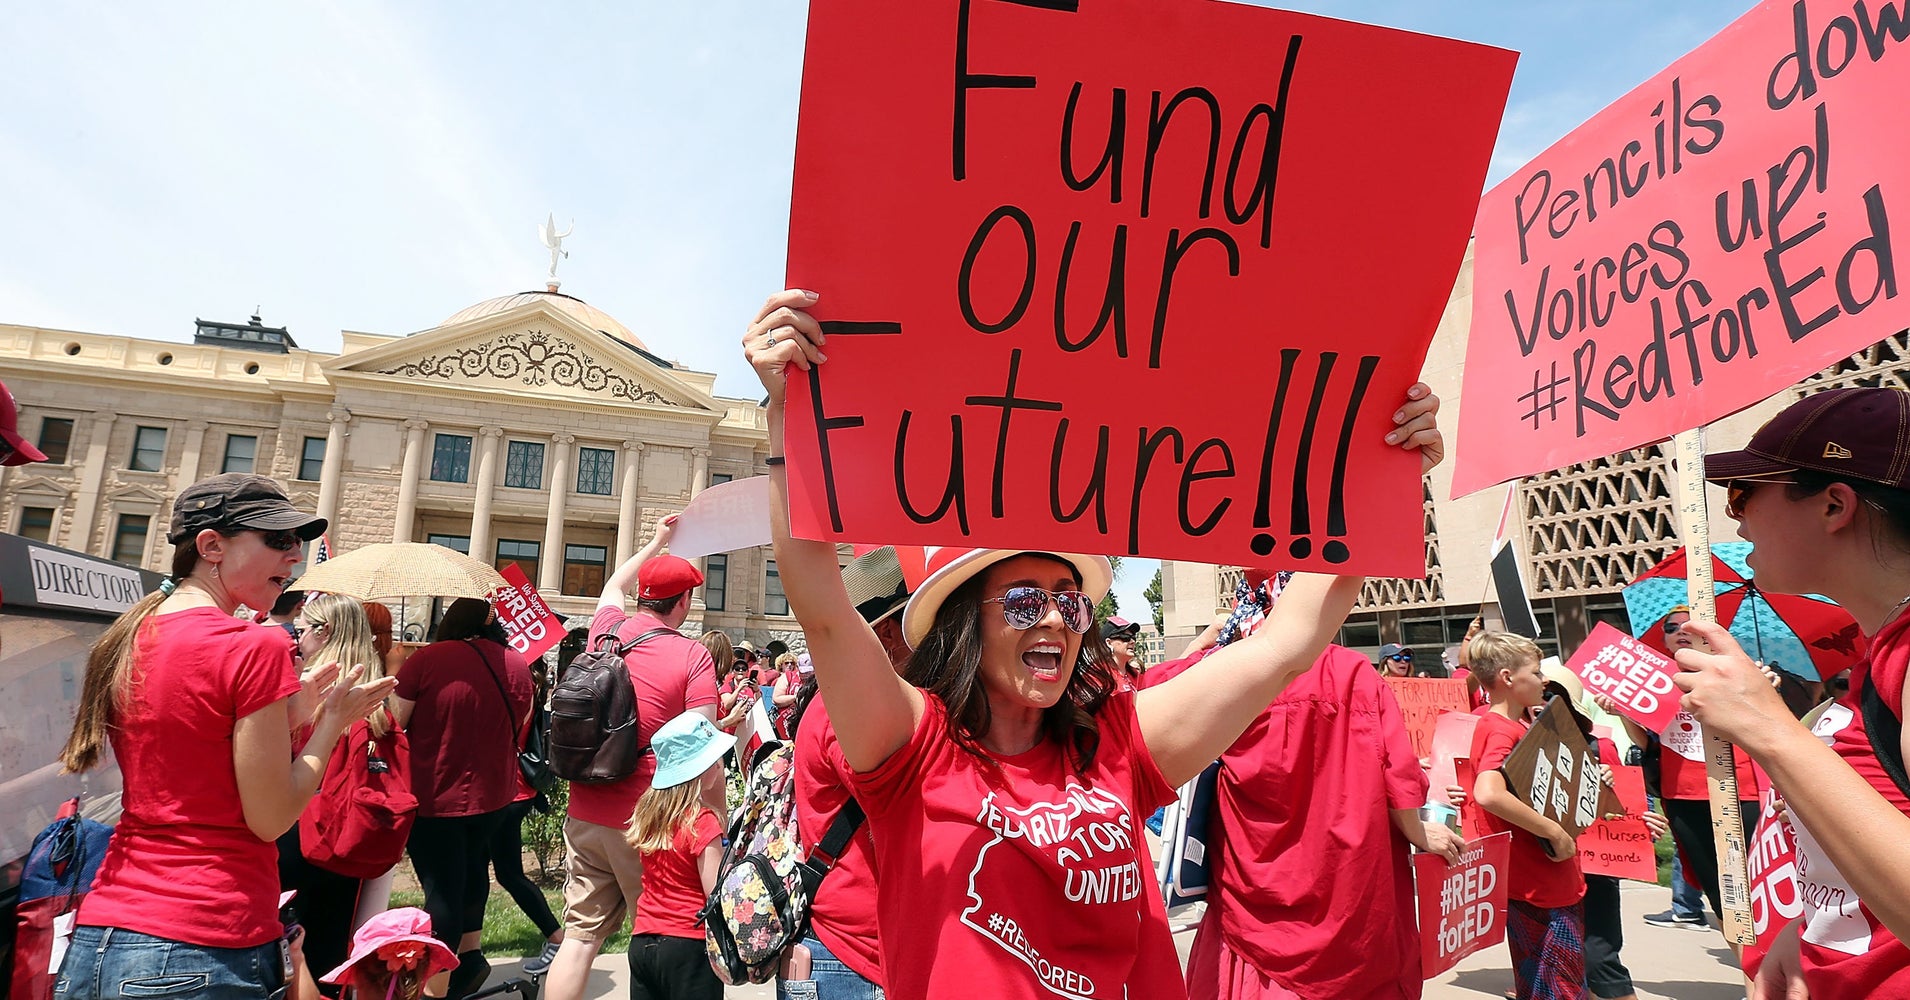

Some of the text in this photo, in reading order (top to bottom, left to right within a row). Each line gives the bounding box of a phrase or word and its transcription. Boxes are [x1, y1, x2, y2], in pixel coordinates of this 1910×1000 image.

[952, 0, 1302, 249] Fund
[1514, 76, 1725, 265] Pencils
[1504, 101, 1829, 358] Voices up!
[957, 204, 1240, 369] our
[1517, 183, 1898, 438] #RedforEd
[807, 321, 1380, 565] Future!!!
[32, 558, 142, 604] DIRECTORY
[498, 586, 547, 641] #RED
[1596, 644, 1674, 695] #RED
[1620, 636, 1668, 669] We Support
[1580, 660, 1659, 714] forED
[1532, 766, 1548, 806] This
[1560, 755, 1571, 773] A
[1458, 845, 1484, 868] Support
[1598, 824, 1647, 842] Nurses
[1600, 852, 1641, 867] guards
[1064, 861, 1141, 905] UNITED
[1440, 864, 1497, 917] #RED
[1437, 902, 1494, 958] forED
